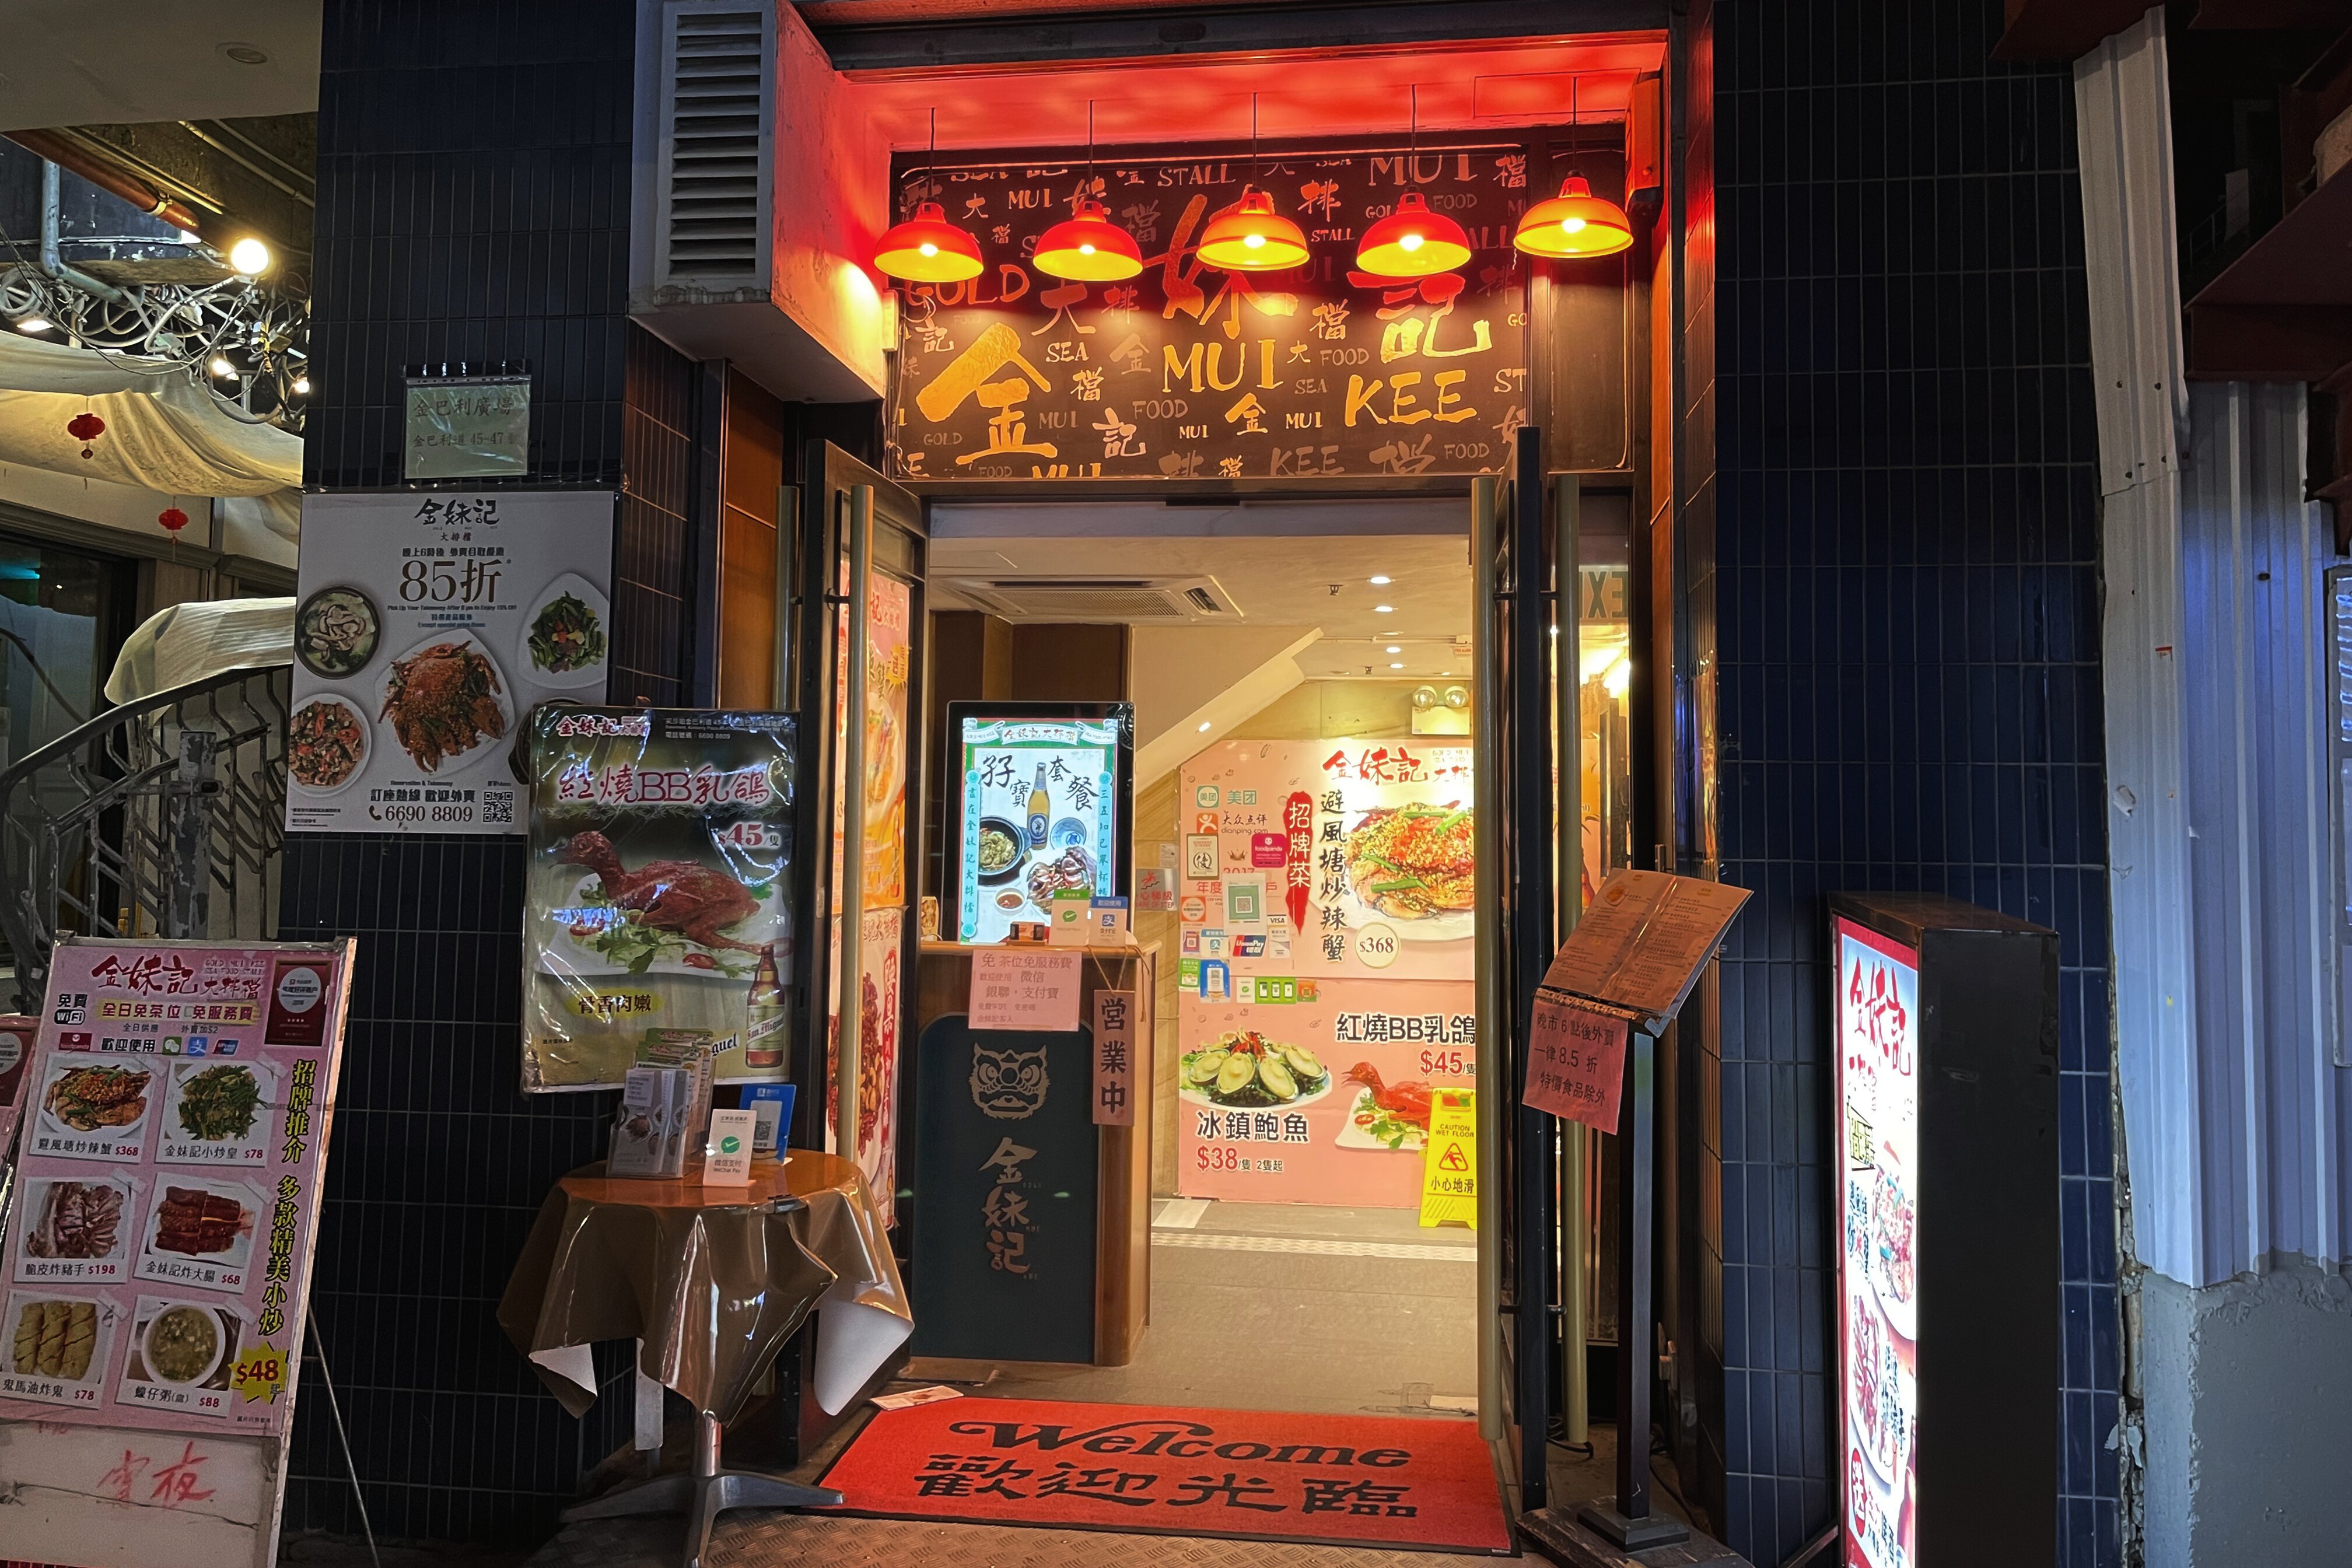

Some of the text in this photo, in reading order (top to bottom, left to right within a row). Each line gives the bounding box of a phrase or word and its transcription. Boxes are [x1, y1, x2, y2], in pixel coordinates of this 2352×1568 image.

[1157, 164, 1237, 187] STALL
[1368, 154, 1479, 186] MUI
[962, 192, 989, 219] 大
[1008, 187, 1054, 209] MUI
[1432, 193, 1478, 210] FOOD
[1310, 228, 1356, 243] STALL
[1045, 342, 1090, 363] SEA
[1109, 333, 1152, 376] 金
[1286, 340, 1312, 365] 大
[1320, 347, 1370, 366] FOOD
[1162, 338, 1284, 393] MUI
[915, 322, 1059, 467] 金
[1294, 378, 1328, 395] SEA
[414, 397, 514, 418] 金巴利廣場
[1132, 399, 1189, 419] FOOD
[1343, 369, 1478, 428] KEE
[1038, 410, 1079, 429] MUI
[1224, 392, 1268, 435] 金
[1285, 411, 1324, 429] MUI
[923, 432, 963, 446] GOLD
[1092, 407, 1147, 459] 記
[1178, 424, 1210, 439] MUI
[1269, 444, 1345, 477] KEE
[1444, 443, 1490, 460] FOOD
[978, 466, 1013, 478] FOOD
[414, 498, 500, 526] 金妹記
[400, 558, 503, 604] 85折
[1322, 747, 1429, 786] 金妹記
[1227, 789, 1257, 806] 美团
[385, 805, 473, 822] 6690 8809
[1288, 801, 1312, 888] 招牌菜
[1318, 789, 1348, 962] 避風塘炒辣蟹
[1140, 890, 1172, 902] 心梯級
[1359, 937, 1394, 956] $368
[981, 952, 1073, 970] 免 茶位免服務費
[91, 954, 198, 996] 金妹記
[1021, 970, 1045, 984] 微信
[102, 1002, 181, 1020] 全日免茶位
[1336, 1013, 1476, 1045] 紅燒BB乳鴿
[712, 1032, 738, 1056] guel
[1540, 1070, 1606, 1106] 特價食品除外
[281, 1059, 317, 1164] 招牌推介
[1196, 1111, 1309, 1143] 冰鎮鮑魚
[115, 1145, 139, 1157] $368
[164, 1144, 264, 1159] 金妹記小炒皇 $78
[1256, 1159, 1283, 1172] 2隻起
[1430, 1175, 1475, 1194] 小心地滑
[978, 1136, 1038, 1274] 金妹記
[257, 1174, 302, 1337] 多款精美小炒
[88, 1265, 116, 1275] $198
[221, 1274, 241, 1285] $68
[236, 1358, 279, 1385] $48
[74, 1390, 95, 1401] $78
[198, 1396, 220, 1408] $88
[950, 1419, 1412, 1468] Welcome
[914, 1452, 1418, 1518] 歡迎光臨
